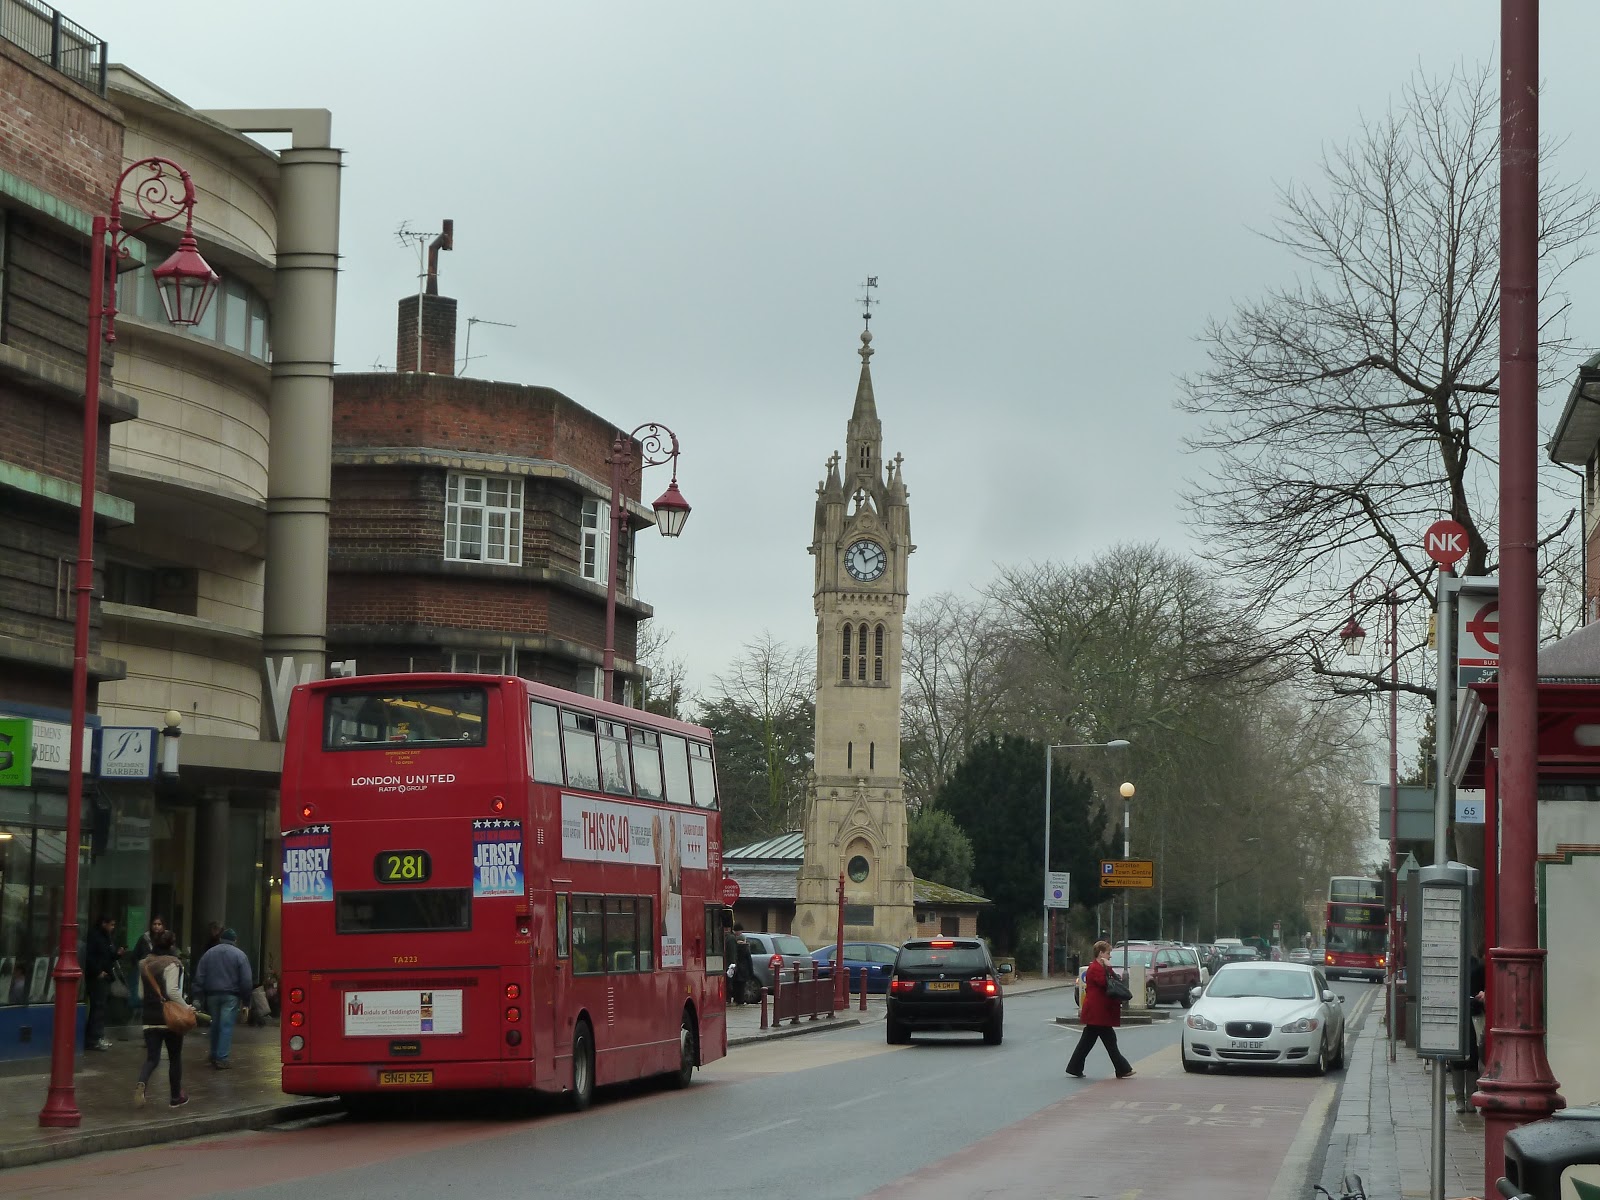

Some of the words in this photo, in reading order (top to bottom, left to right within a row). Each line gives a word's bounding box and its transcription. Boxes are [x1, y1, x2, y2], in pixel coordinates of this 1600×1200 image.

[1429, 533, 1462, 552] NK
[34, 725, 62, 740] TLEMEN'S
[34, 743, 60, 762] RBERS
[351, 776, 400, 786] LONDON
[406, 774, 455, 784] UNITED
[1464, 807, 1475, 815] 65
[582, 811, 605, 851] THIS
[606, 814, 616, 852] IS
[618, 815, 629, 854] 40
[283, 848, 330, 873] JERSEY
[474, 843, 521, 867] JERSEY
[388, 856, 422, 878] 281
[480, 865, 516, 888] BOYS
[1105, 864, 1112, 873] P
[289, 871, 326, 893] BOYS
[348, 1002, 380, 1016] Moiduls
[384, 1073, 406, 1083] SN51
[409, 1073, 429, 1082] SZE
